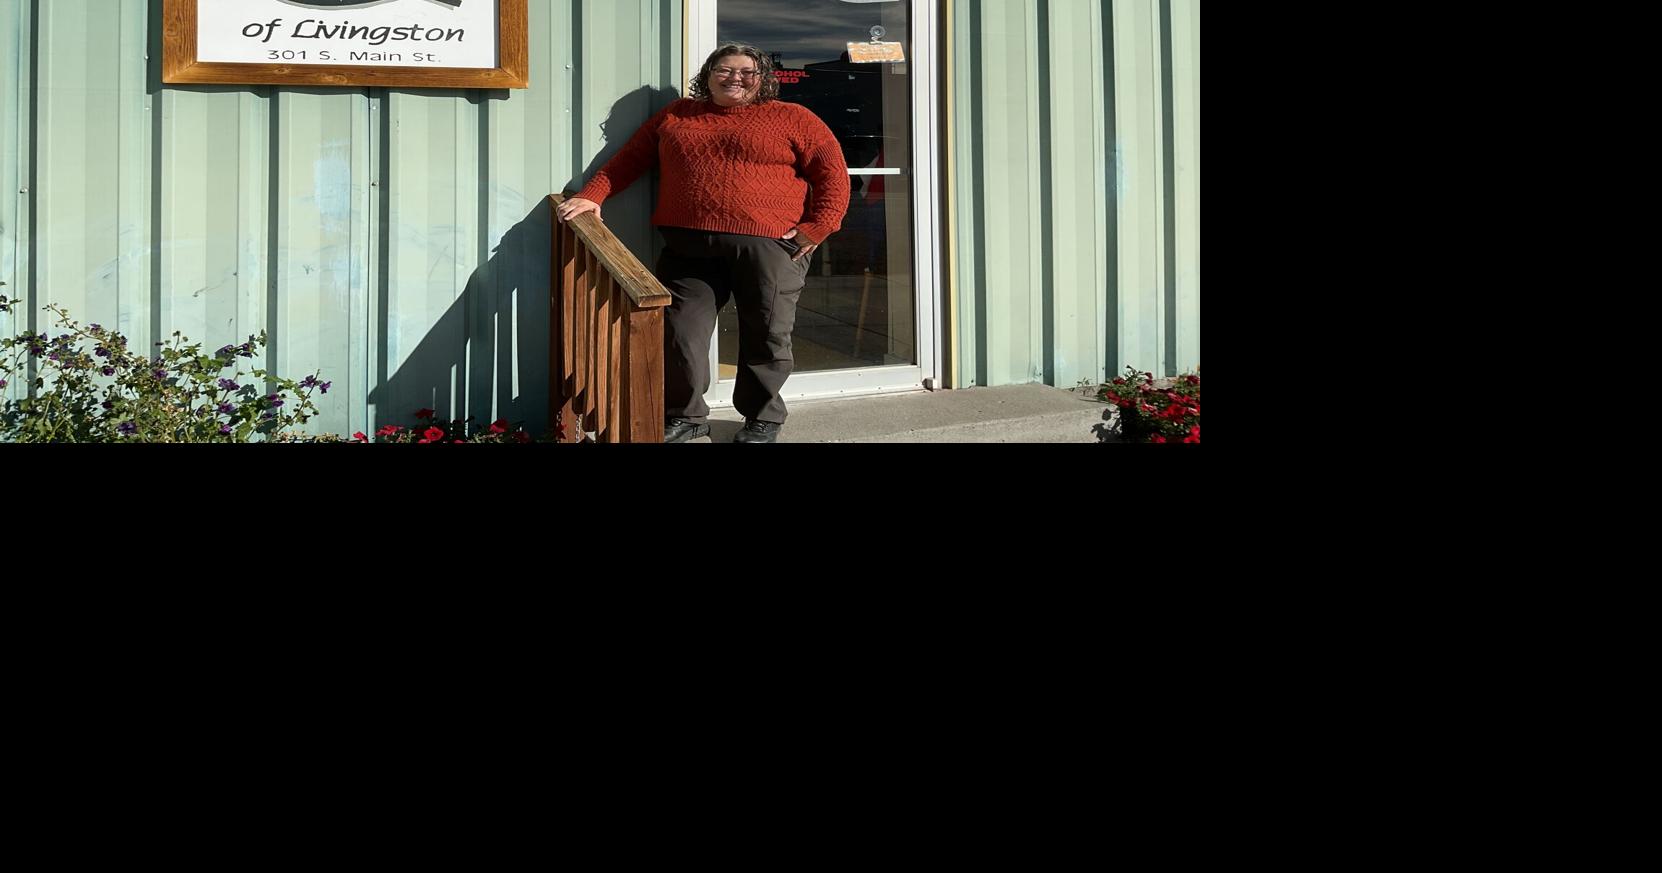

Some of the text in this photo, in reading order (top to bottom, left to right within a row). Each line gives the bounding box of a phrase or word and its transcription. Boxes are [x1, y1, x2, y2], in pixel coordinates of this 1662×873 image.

[242, 19, 465, 46] of Livingston
[268, 50, 441, 63] 301 S. Main St.
